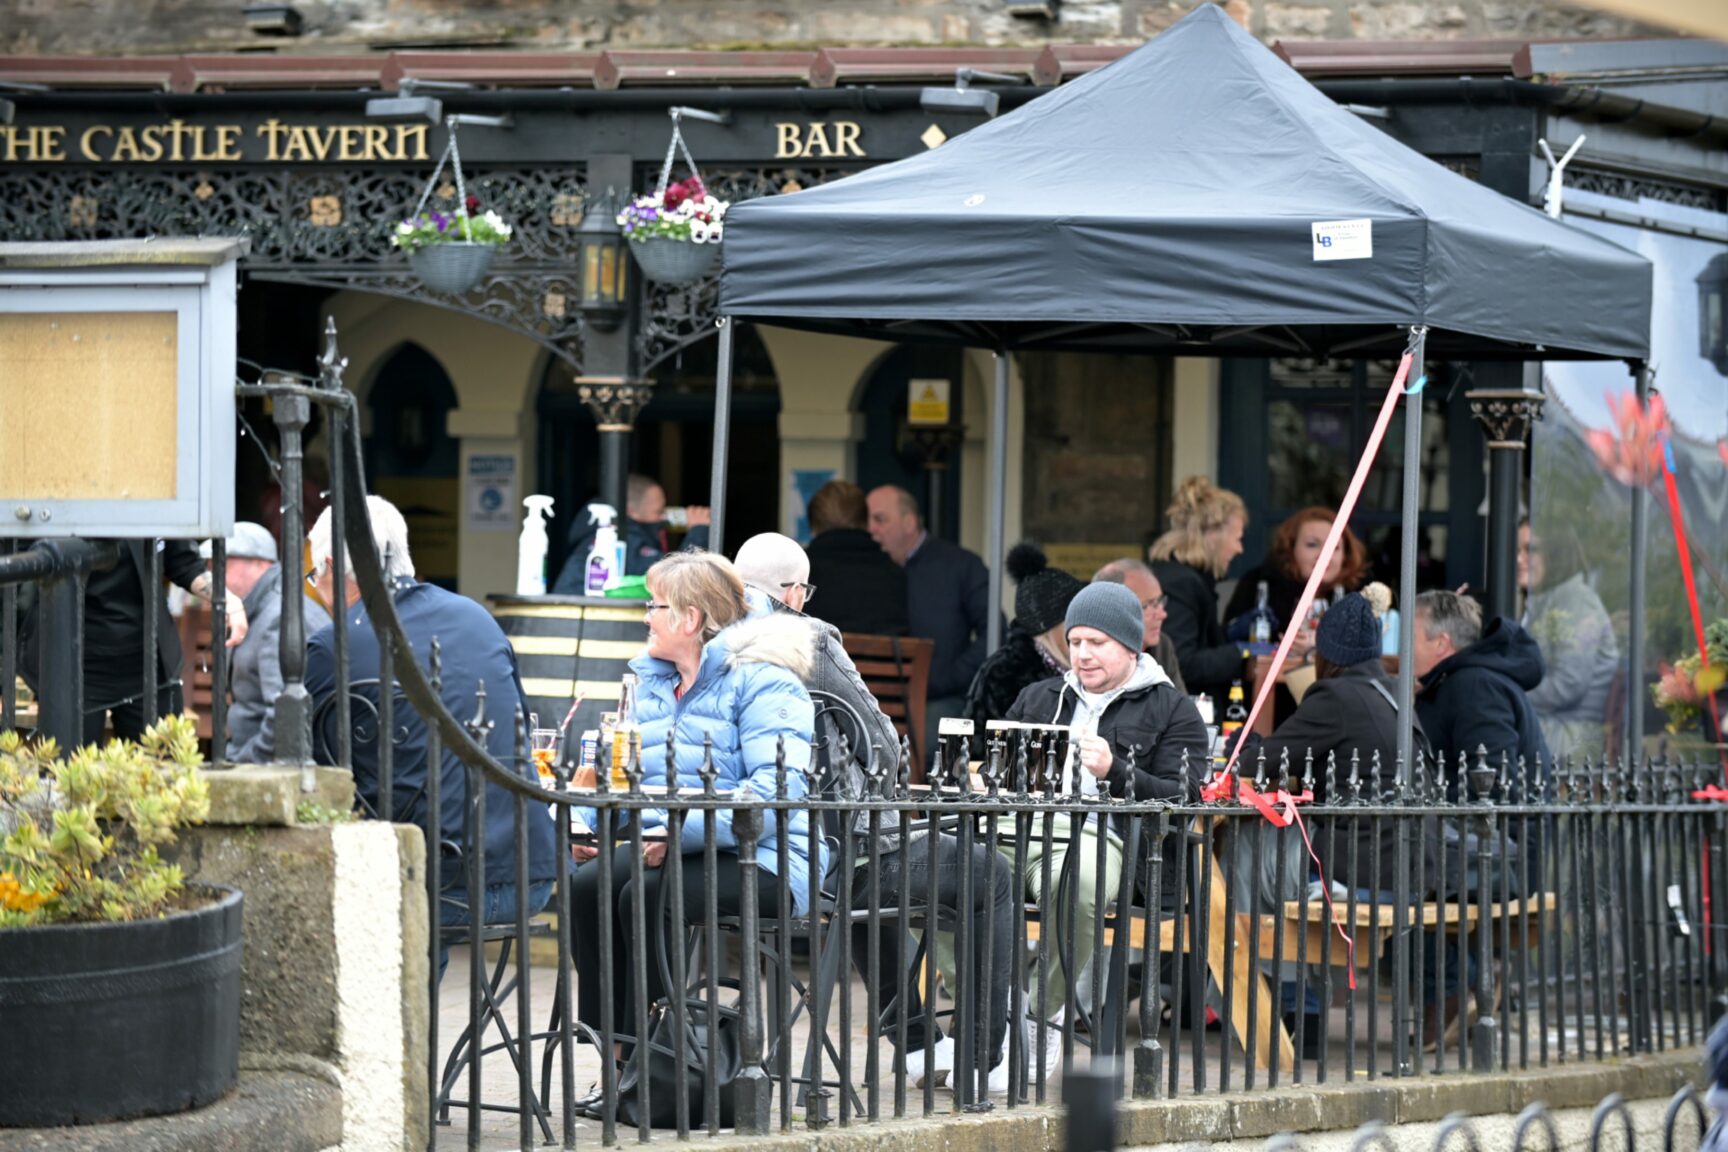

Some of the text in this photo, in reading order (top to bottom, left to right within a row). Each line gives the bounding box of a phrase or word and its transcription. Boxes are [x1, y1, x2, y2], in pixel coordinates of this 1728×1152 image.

[80, 119, 242, 162] CASTLE
[257, 119, 429, 161] TAVERN
[774, 121, 867, 159] BAR
